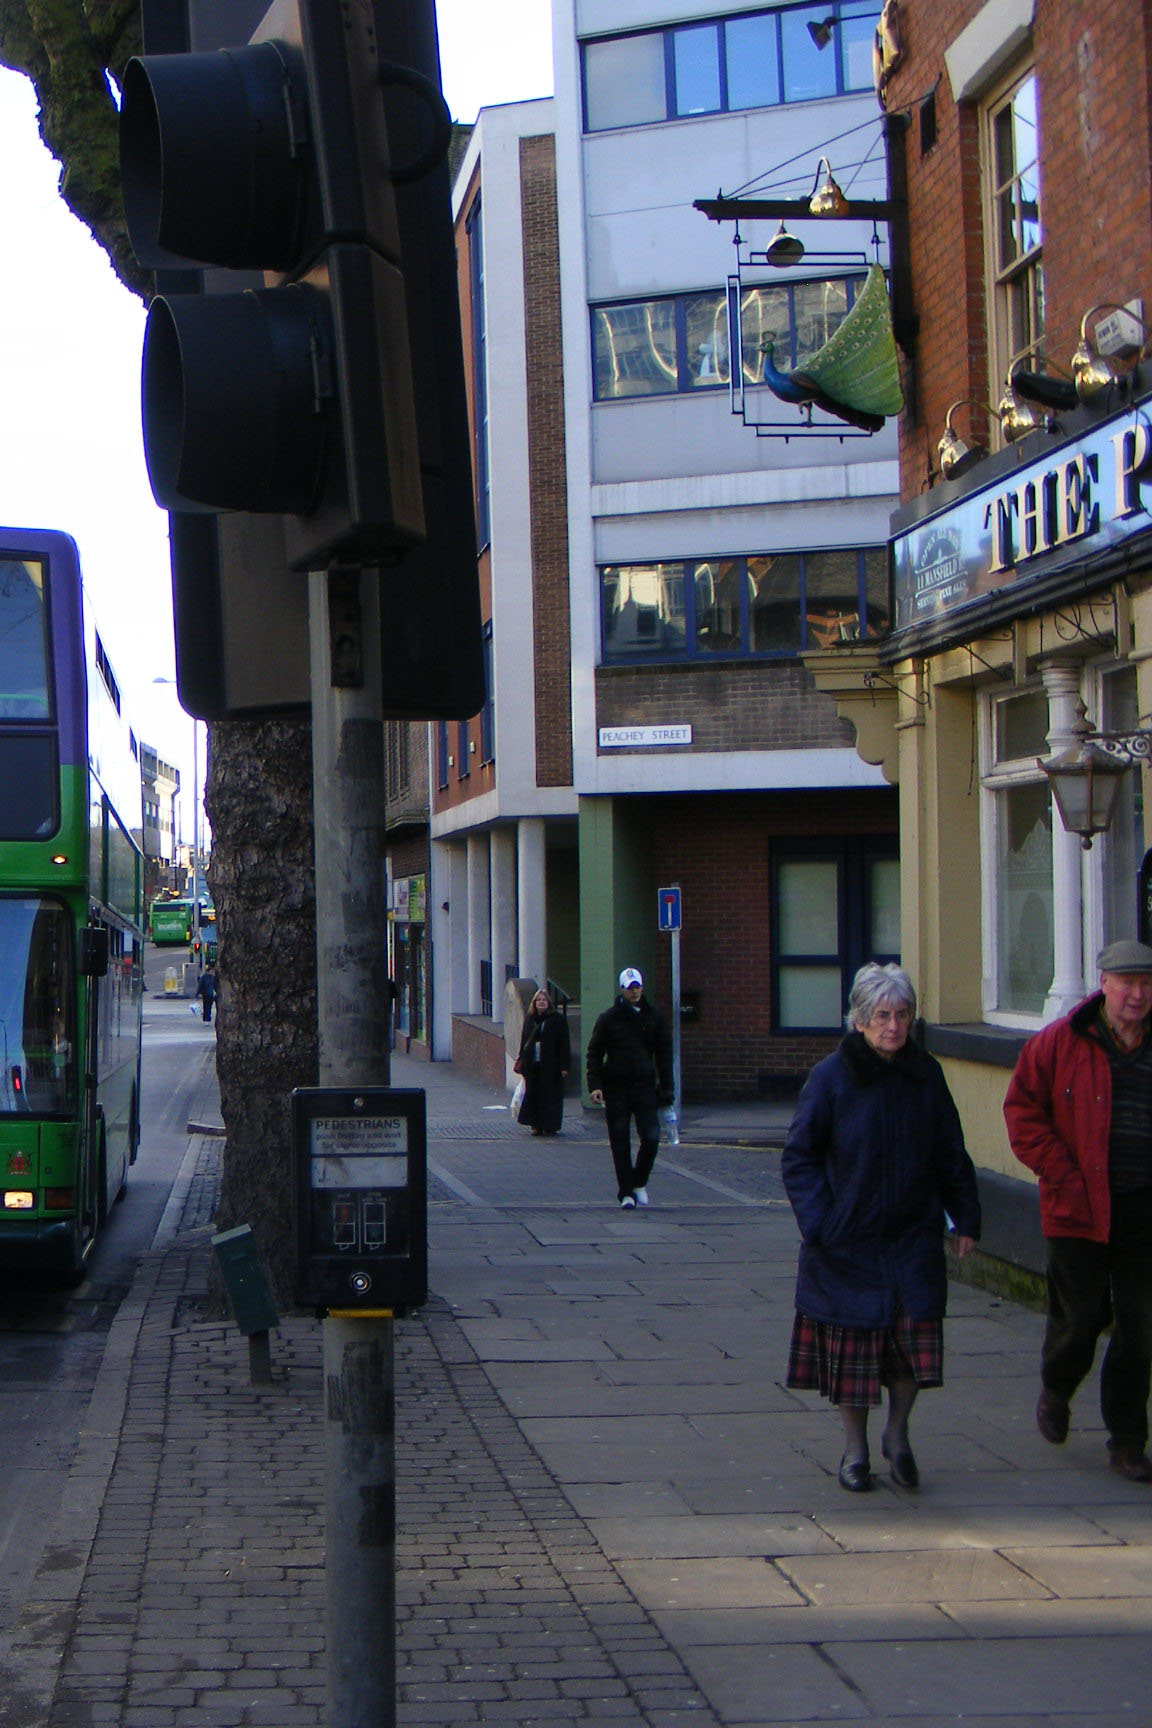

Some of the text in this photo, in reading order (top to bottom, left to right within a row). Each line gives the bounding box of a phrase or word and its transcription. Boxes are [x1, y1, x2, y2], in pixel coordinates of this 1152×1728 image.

[983, 453, 1094, 574] THE
[925, 557, 958, 587] MANSFIELD
[602, 729, 689, 742] PEACHEY STREET
[316, 1119, 401, 1131] PEDESTRIANS
